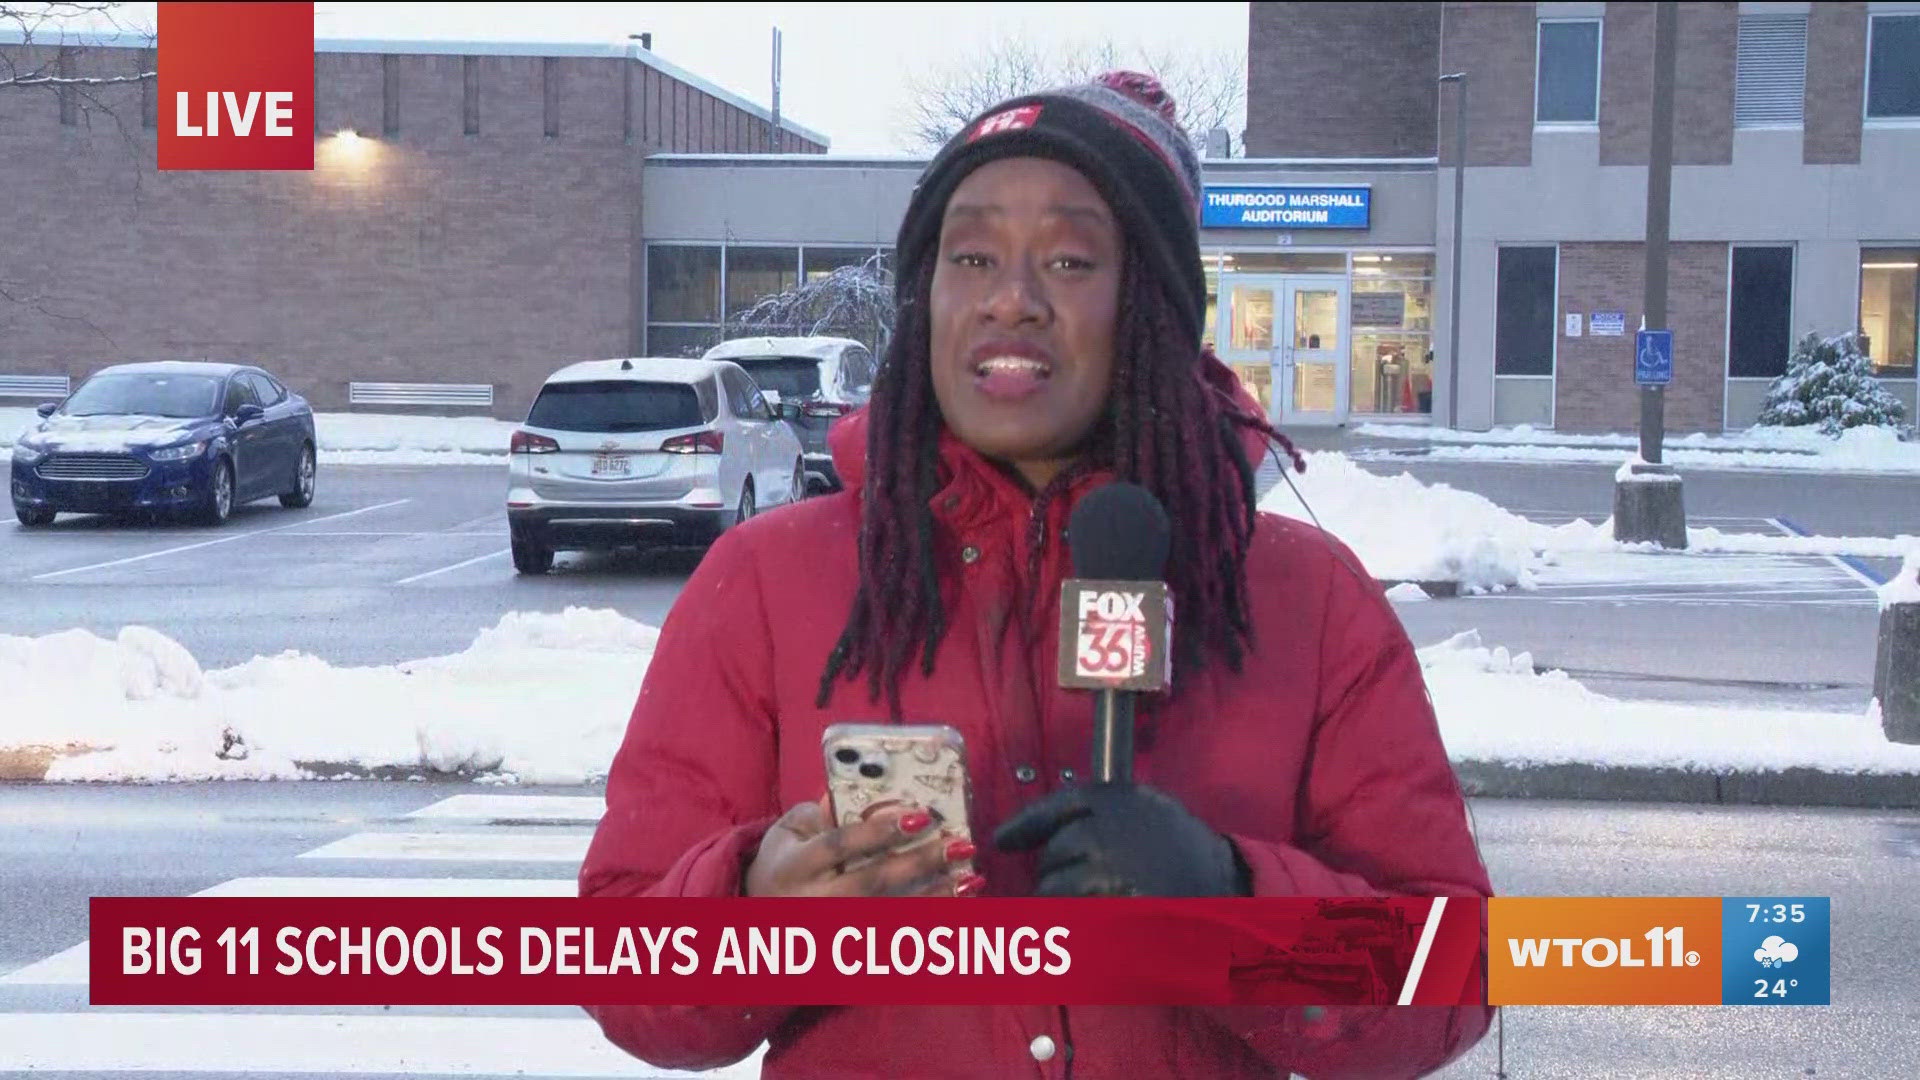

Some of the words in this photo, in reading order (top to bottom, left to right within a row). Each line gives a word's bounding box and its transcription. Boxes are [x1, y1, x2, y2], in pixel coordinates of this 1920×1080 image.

[1207, 193, 1286, 206] THURGOOD
[1289, 194, 1364, 207] MARSHALL
[1241, 210, 1328, 222] AUDITORIUM
[1079, 590, 1146, 621] FOX
[1079, 626, 1129, 673] 36
